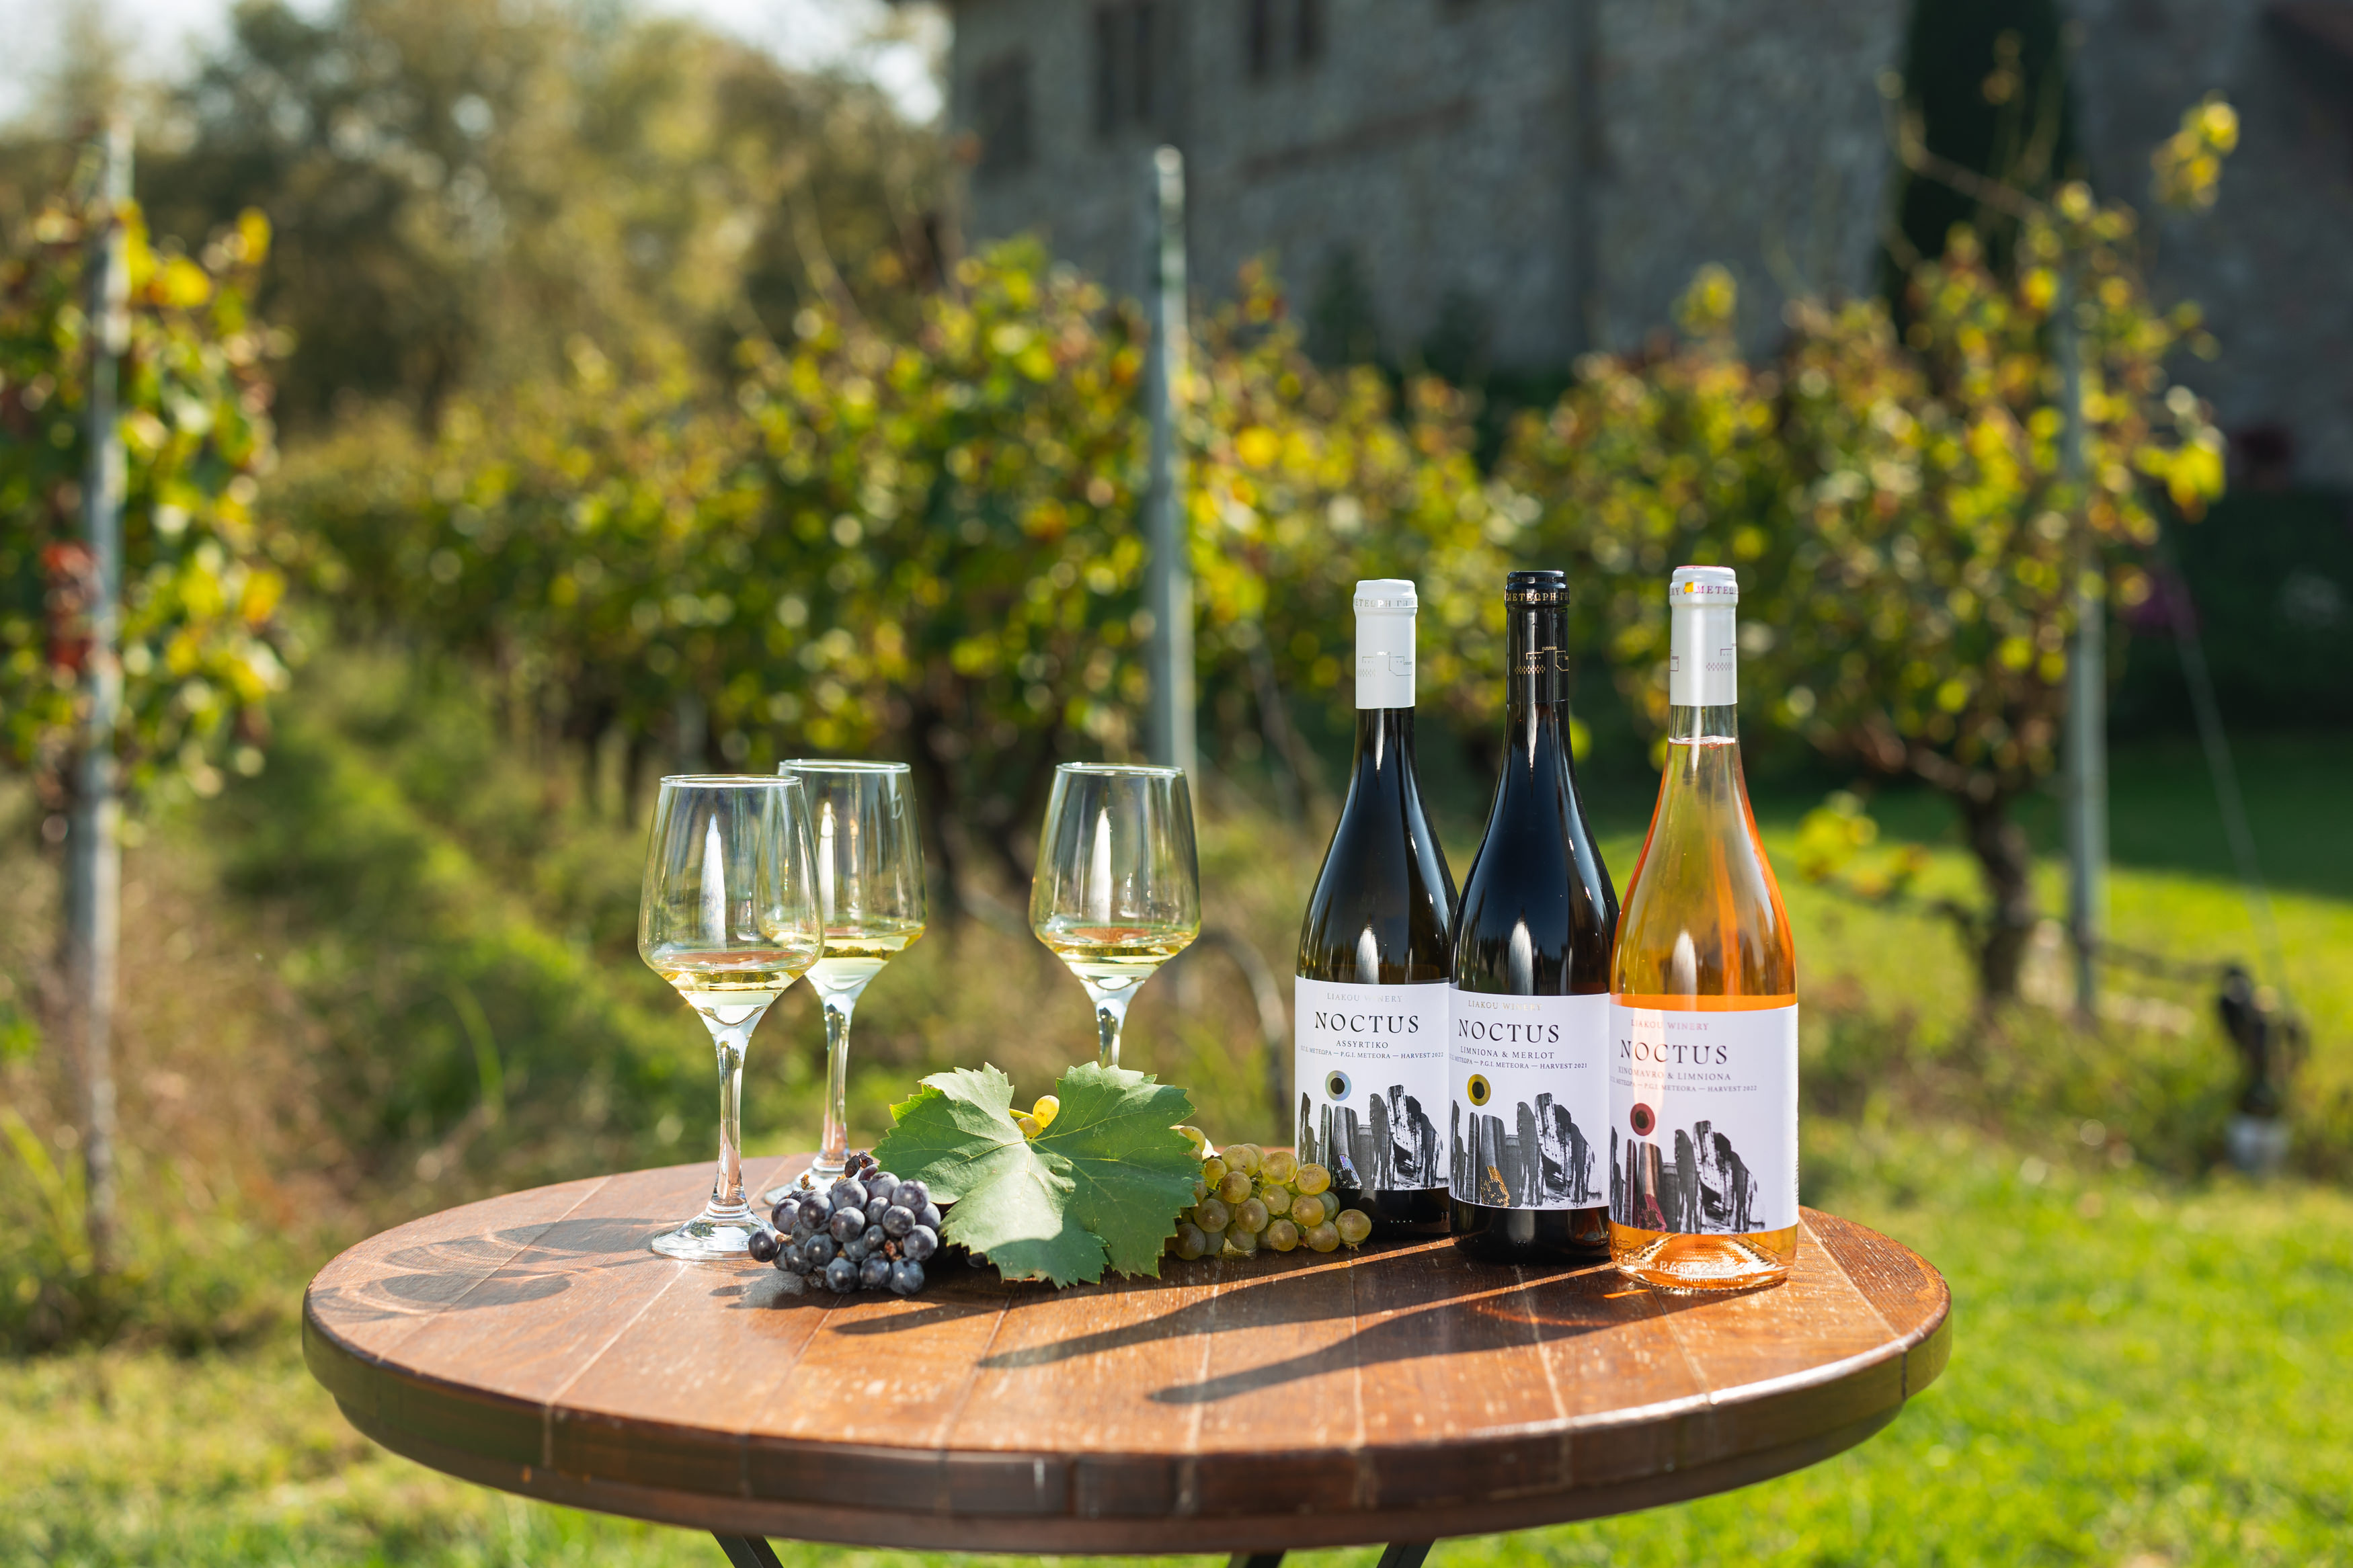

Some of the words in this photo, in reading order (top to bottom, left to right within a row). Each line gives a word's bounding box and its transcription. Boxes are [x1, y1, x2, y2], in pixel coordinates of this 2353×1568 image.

[1327, 993, 1360, 1001] LIAKOU
[1364, 995, 1403, 1003] WNERY
[1468, 1000, 1499, 1009] LIAKOU
[1501, 1002, 1543, 1011] WINERY
[1315, 1012, 1419, 1034] NOCTUS
[1631, 1019, 1663, 1029] LIAKOU
[1667, 1022, 1709, 1030] WINERY
[1458, 1018, 1559, 1043] NOCTUS
[1336, 1040, 1388, 1048] ASSYRTIKO
[1460, 1046, 1498, 1057] LIMNIONA
[1512, 1051, 1554, 1059] MERLOT
[1620, 1039, 1728, 1065] NOCTUS
[1496, 1061, 1529, 1069] METEORA
[1618, 1066, 1664, 1079] XINOMAVRO
[1678, 1072, 1731, 1081] LIMNIONA
